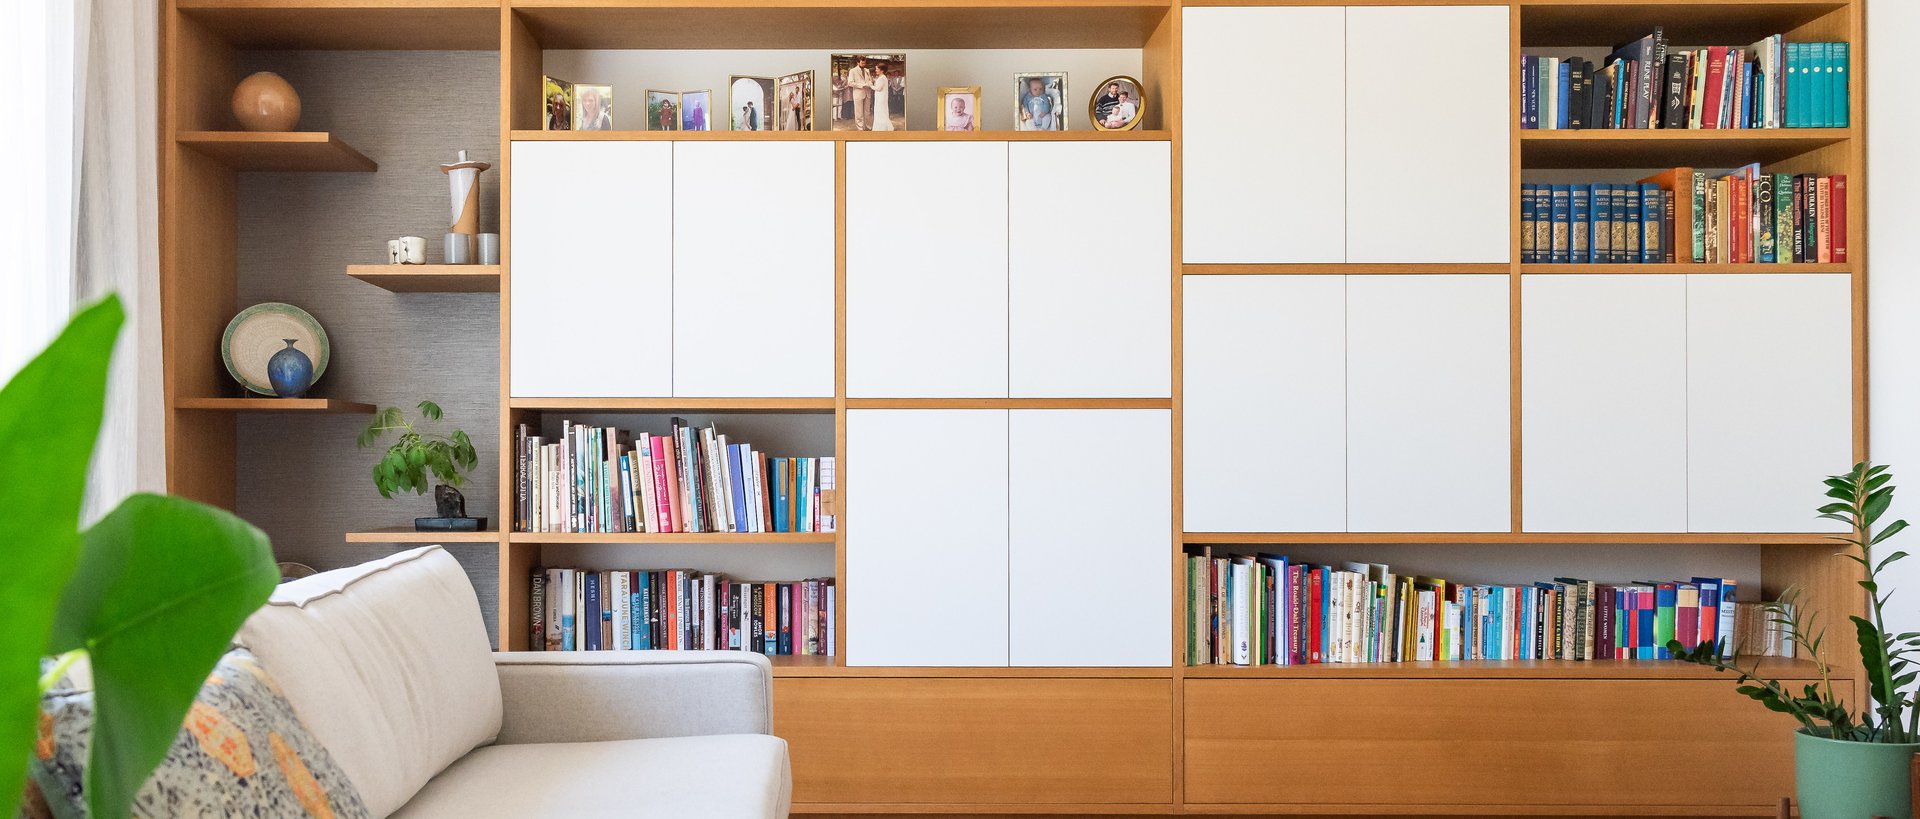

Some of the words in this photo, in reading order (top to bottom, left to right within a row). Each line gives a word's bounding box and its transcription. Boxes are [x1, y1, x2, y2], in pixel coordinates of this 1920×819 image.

[533, 578, 541, 594] DAN
[620, 574, 628, 596] TARA
[533, 596, 542, 626] BROWN
[1291, 625, 1300, 653] Treasury
